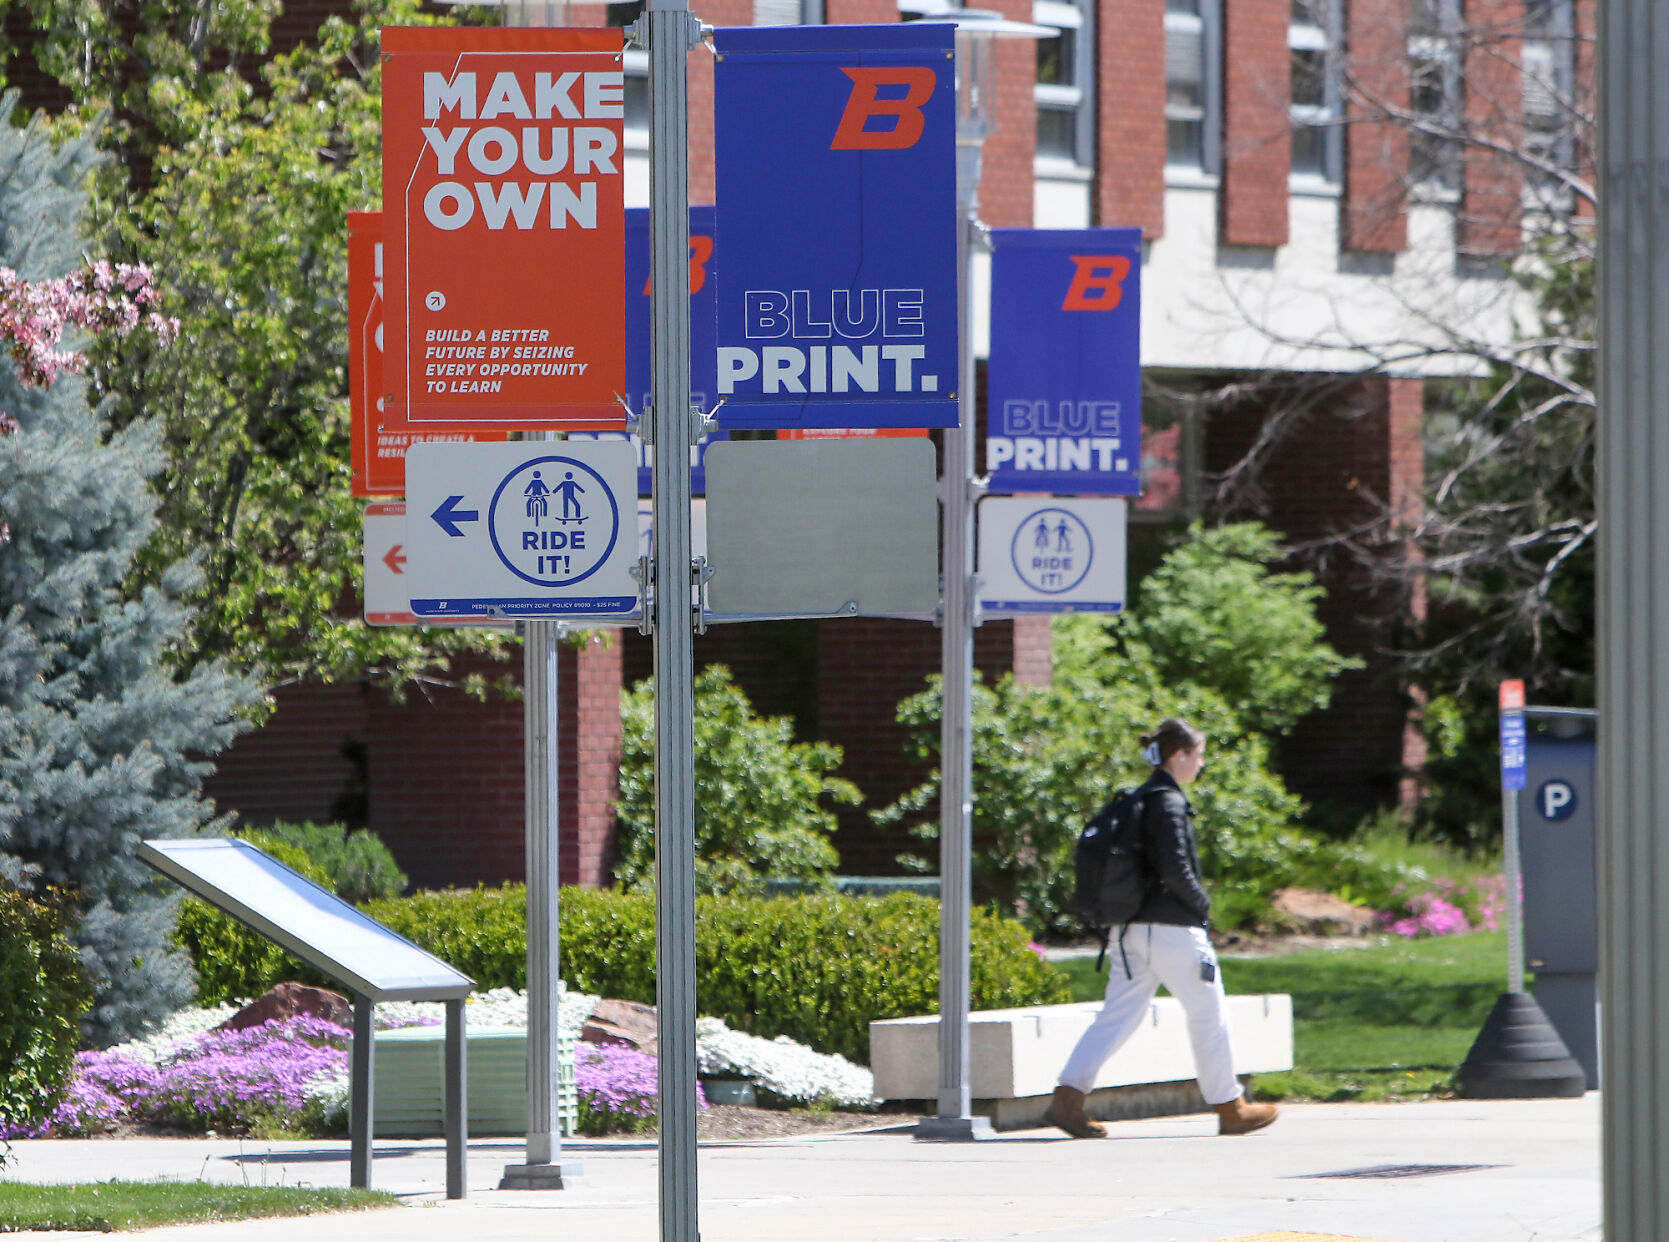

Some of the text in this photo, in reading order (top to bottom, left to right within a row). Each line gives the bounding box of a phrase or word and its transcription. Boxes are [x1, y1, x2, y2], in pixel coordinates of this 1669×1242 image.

[424, 72, 624, 119] MAKE
[830, 67, 937, 150] B
[421, 127, 619, 175] YOUR
[423, 182, 597, 230] OWN
[1061, 256, 1131, 312] B
[745, 289, 925, 338] BLUE
[425, 329, 550, 342] BUILD A BETTER
[425, 346, 574, 359] FUTURE BY SEIZING
[425, 363, 588, 376] EVERY OPPORTUNITY
[717, 345, 938, 394] PRINT.
[426, 381, 502, 393] TO LEARN
[1003, 400, 1120, 436] BLUE
[377, 435, 408, 446] IDEAS
[986, 437, 1128, 471] PRINT.
[522, 531, 585, 550] RIDE
[537, 555, 571, 574] IT!
[1032, 557, 1072, 570] RIDE
[1041, 574, 1063, 586] IT!
[1544, 783, 1572, 817] P
